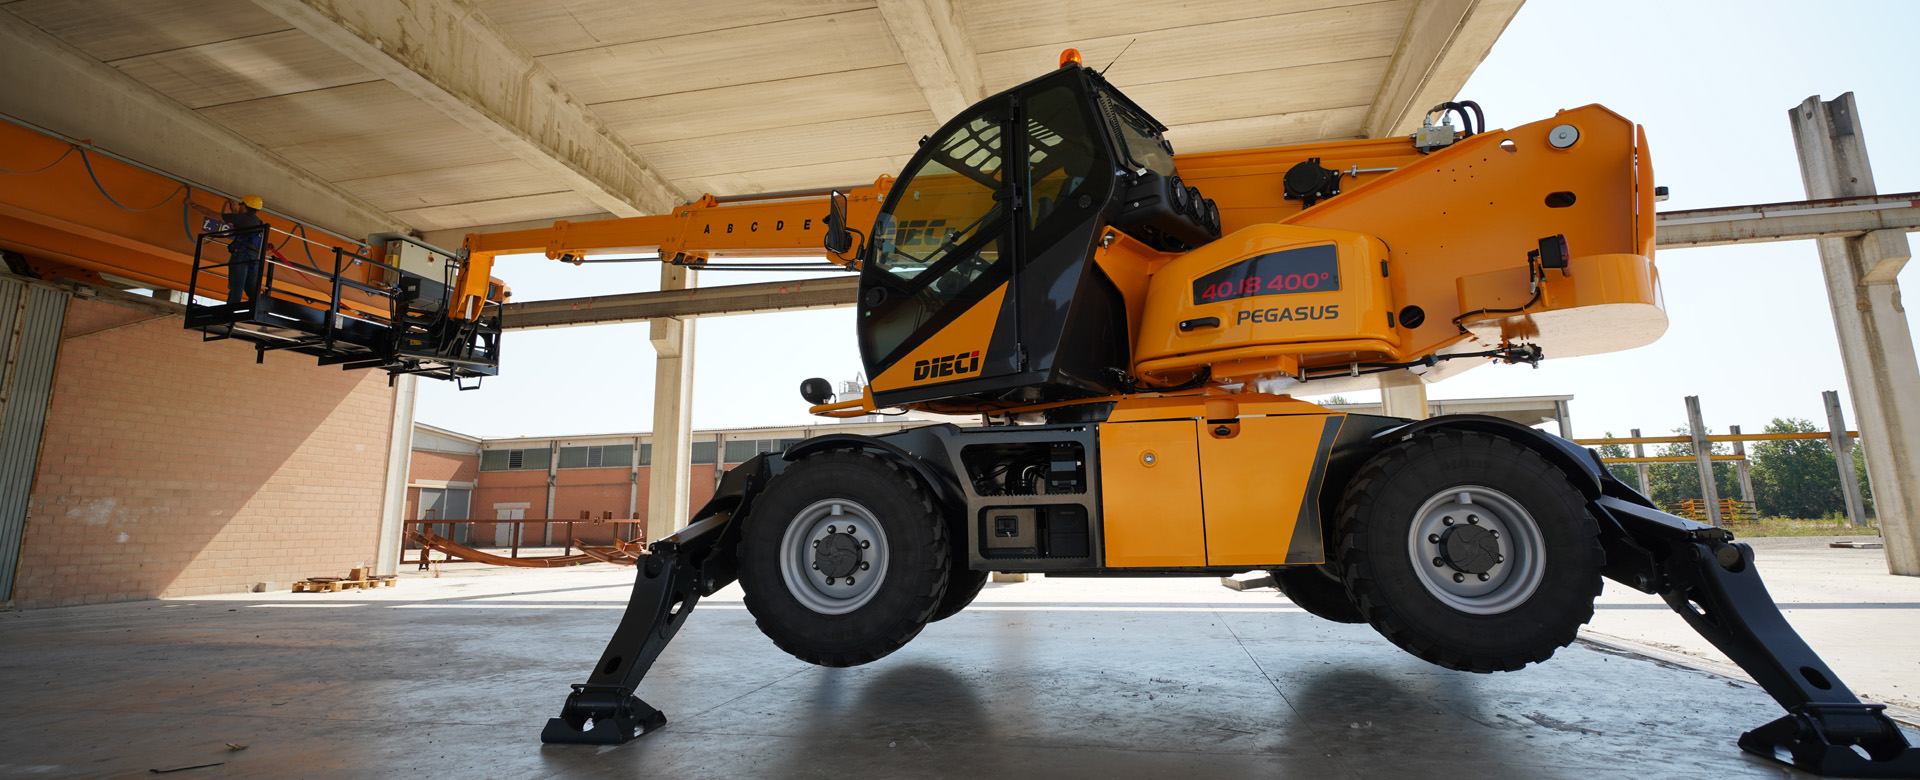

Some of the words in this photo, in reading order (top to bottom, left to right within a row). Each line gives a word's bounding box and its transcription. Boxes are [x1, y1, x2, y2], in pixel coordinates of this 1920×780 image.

[703, 224, 710, 234] A
[727, 223, 733, 233] B
[751, 221, 758, 232] C
[776, 220, 784, 231] D
[803, 219, 811, 230] E
[1202, 277, 1261, 299] 40.18
[1267, 272, 1329, 291] 400°
[1237, 305, 1339, 325] PEGASUS
[914, 350, 979, 381] DIECI
